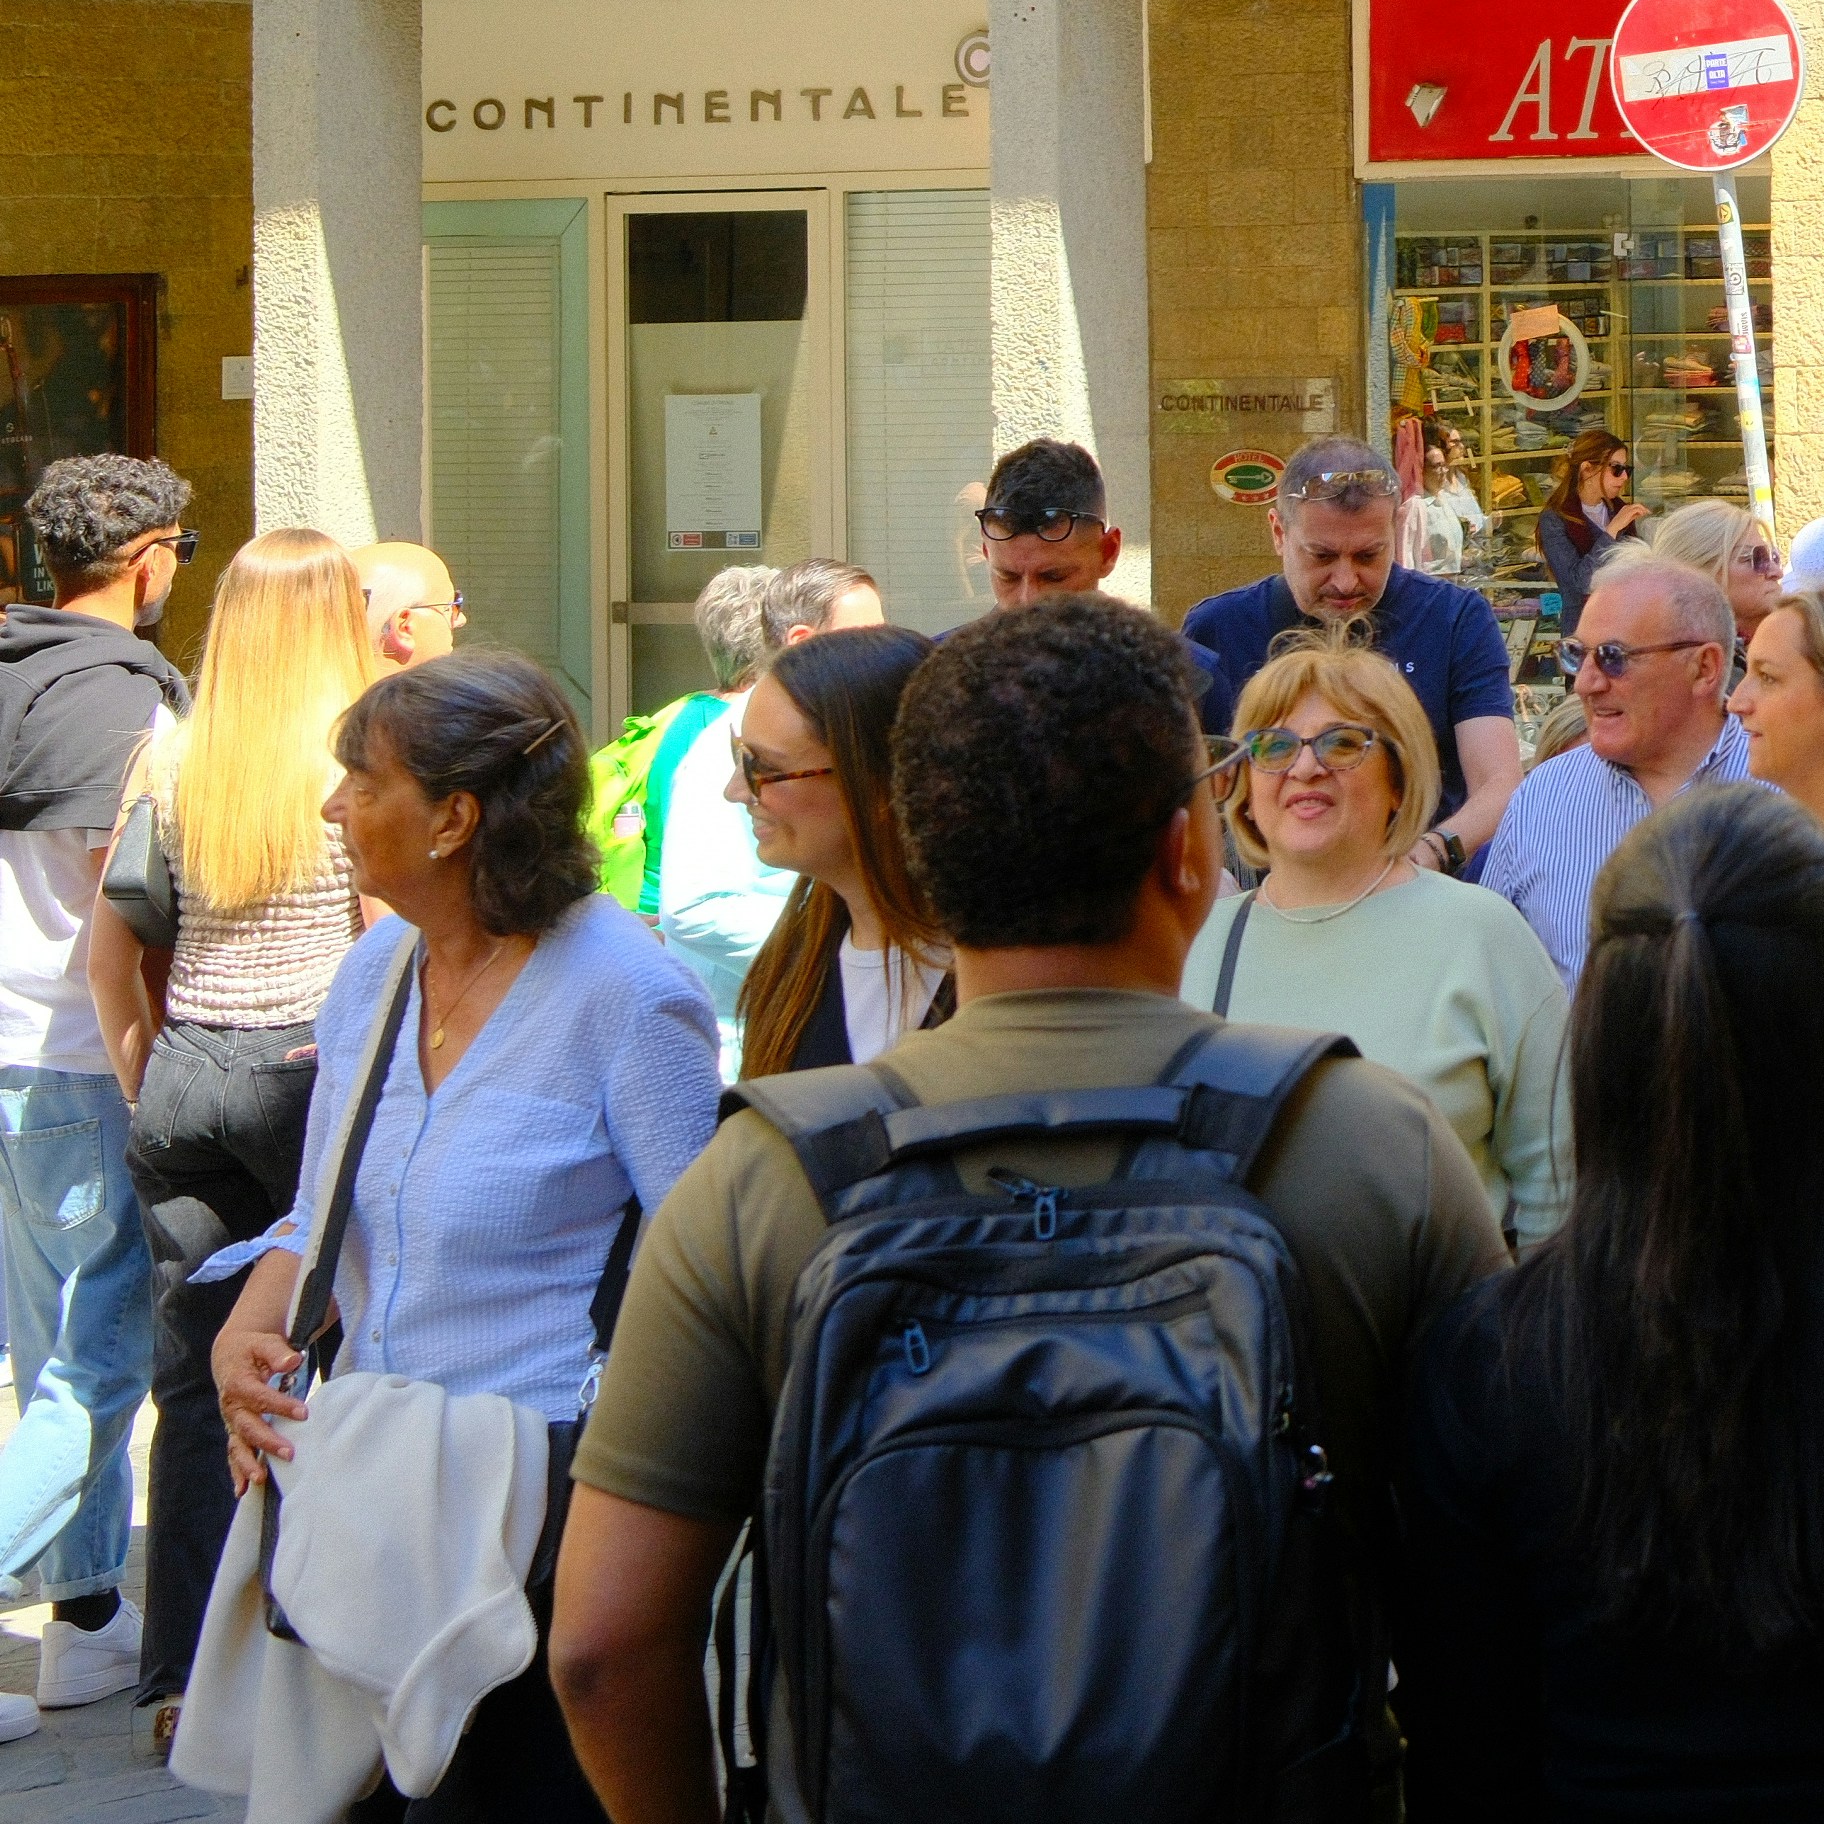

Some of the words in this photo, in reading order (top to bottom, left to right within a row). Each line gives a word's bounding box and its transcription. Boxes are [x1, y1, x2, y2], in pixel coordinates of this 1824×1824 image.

[425, 82, 970, 133] CONTINENTALE
[1488, 37, 1634, 142] AT
[1161, 394, 1324, 412] CONTINENTALE
